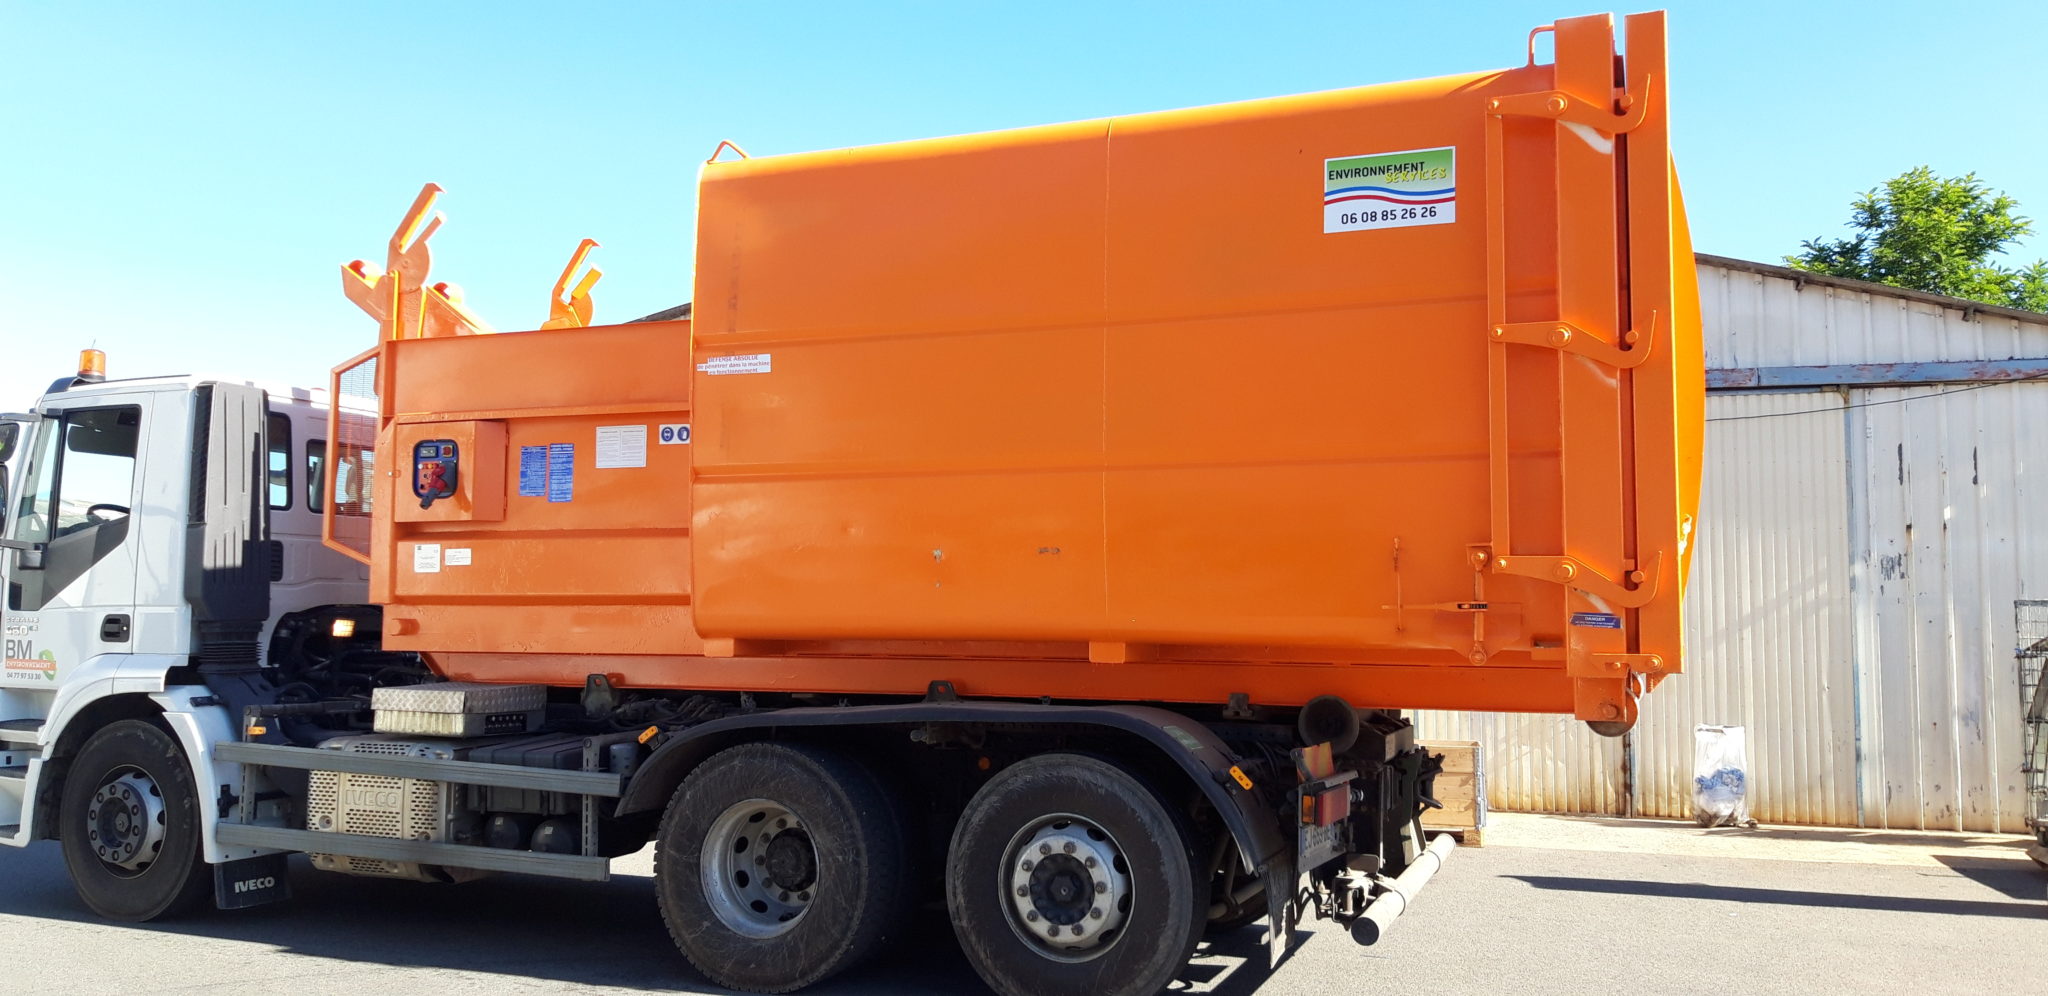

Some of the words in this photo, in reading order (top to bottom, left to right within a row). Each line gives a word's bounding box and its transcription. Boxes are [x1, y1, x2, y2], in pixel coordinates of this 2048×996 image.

[1328, 161, 1425, 181] ENVIRONNEMENT
[1384, 168, 1447, 184] SERVICES
[1341, 212, 1358, 225] 06
[1361, 210, 1378, 224] 08
[1381, 209, 1397, 221] 85
[1401, 207, 1417, 219] 26
[1421, 205, 1437, 218] 26
[6, 639, 33, 659] BM
[344, 789, 399, 808] IVECO
[234, 876, 275, 893] IVECO
